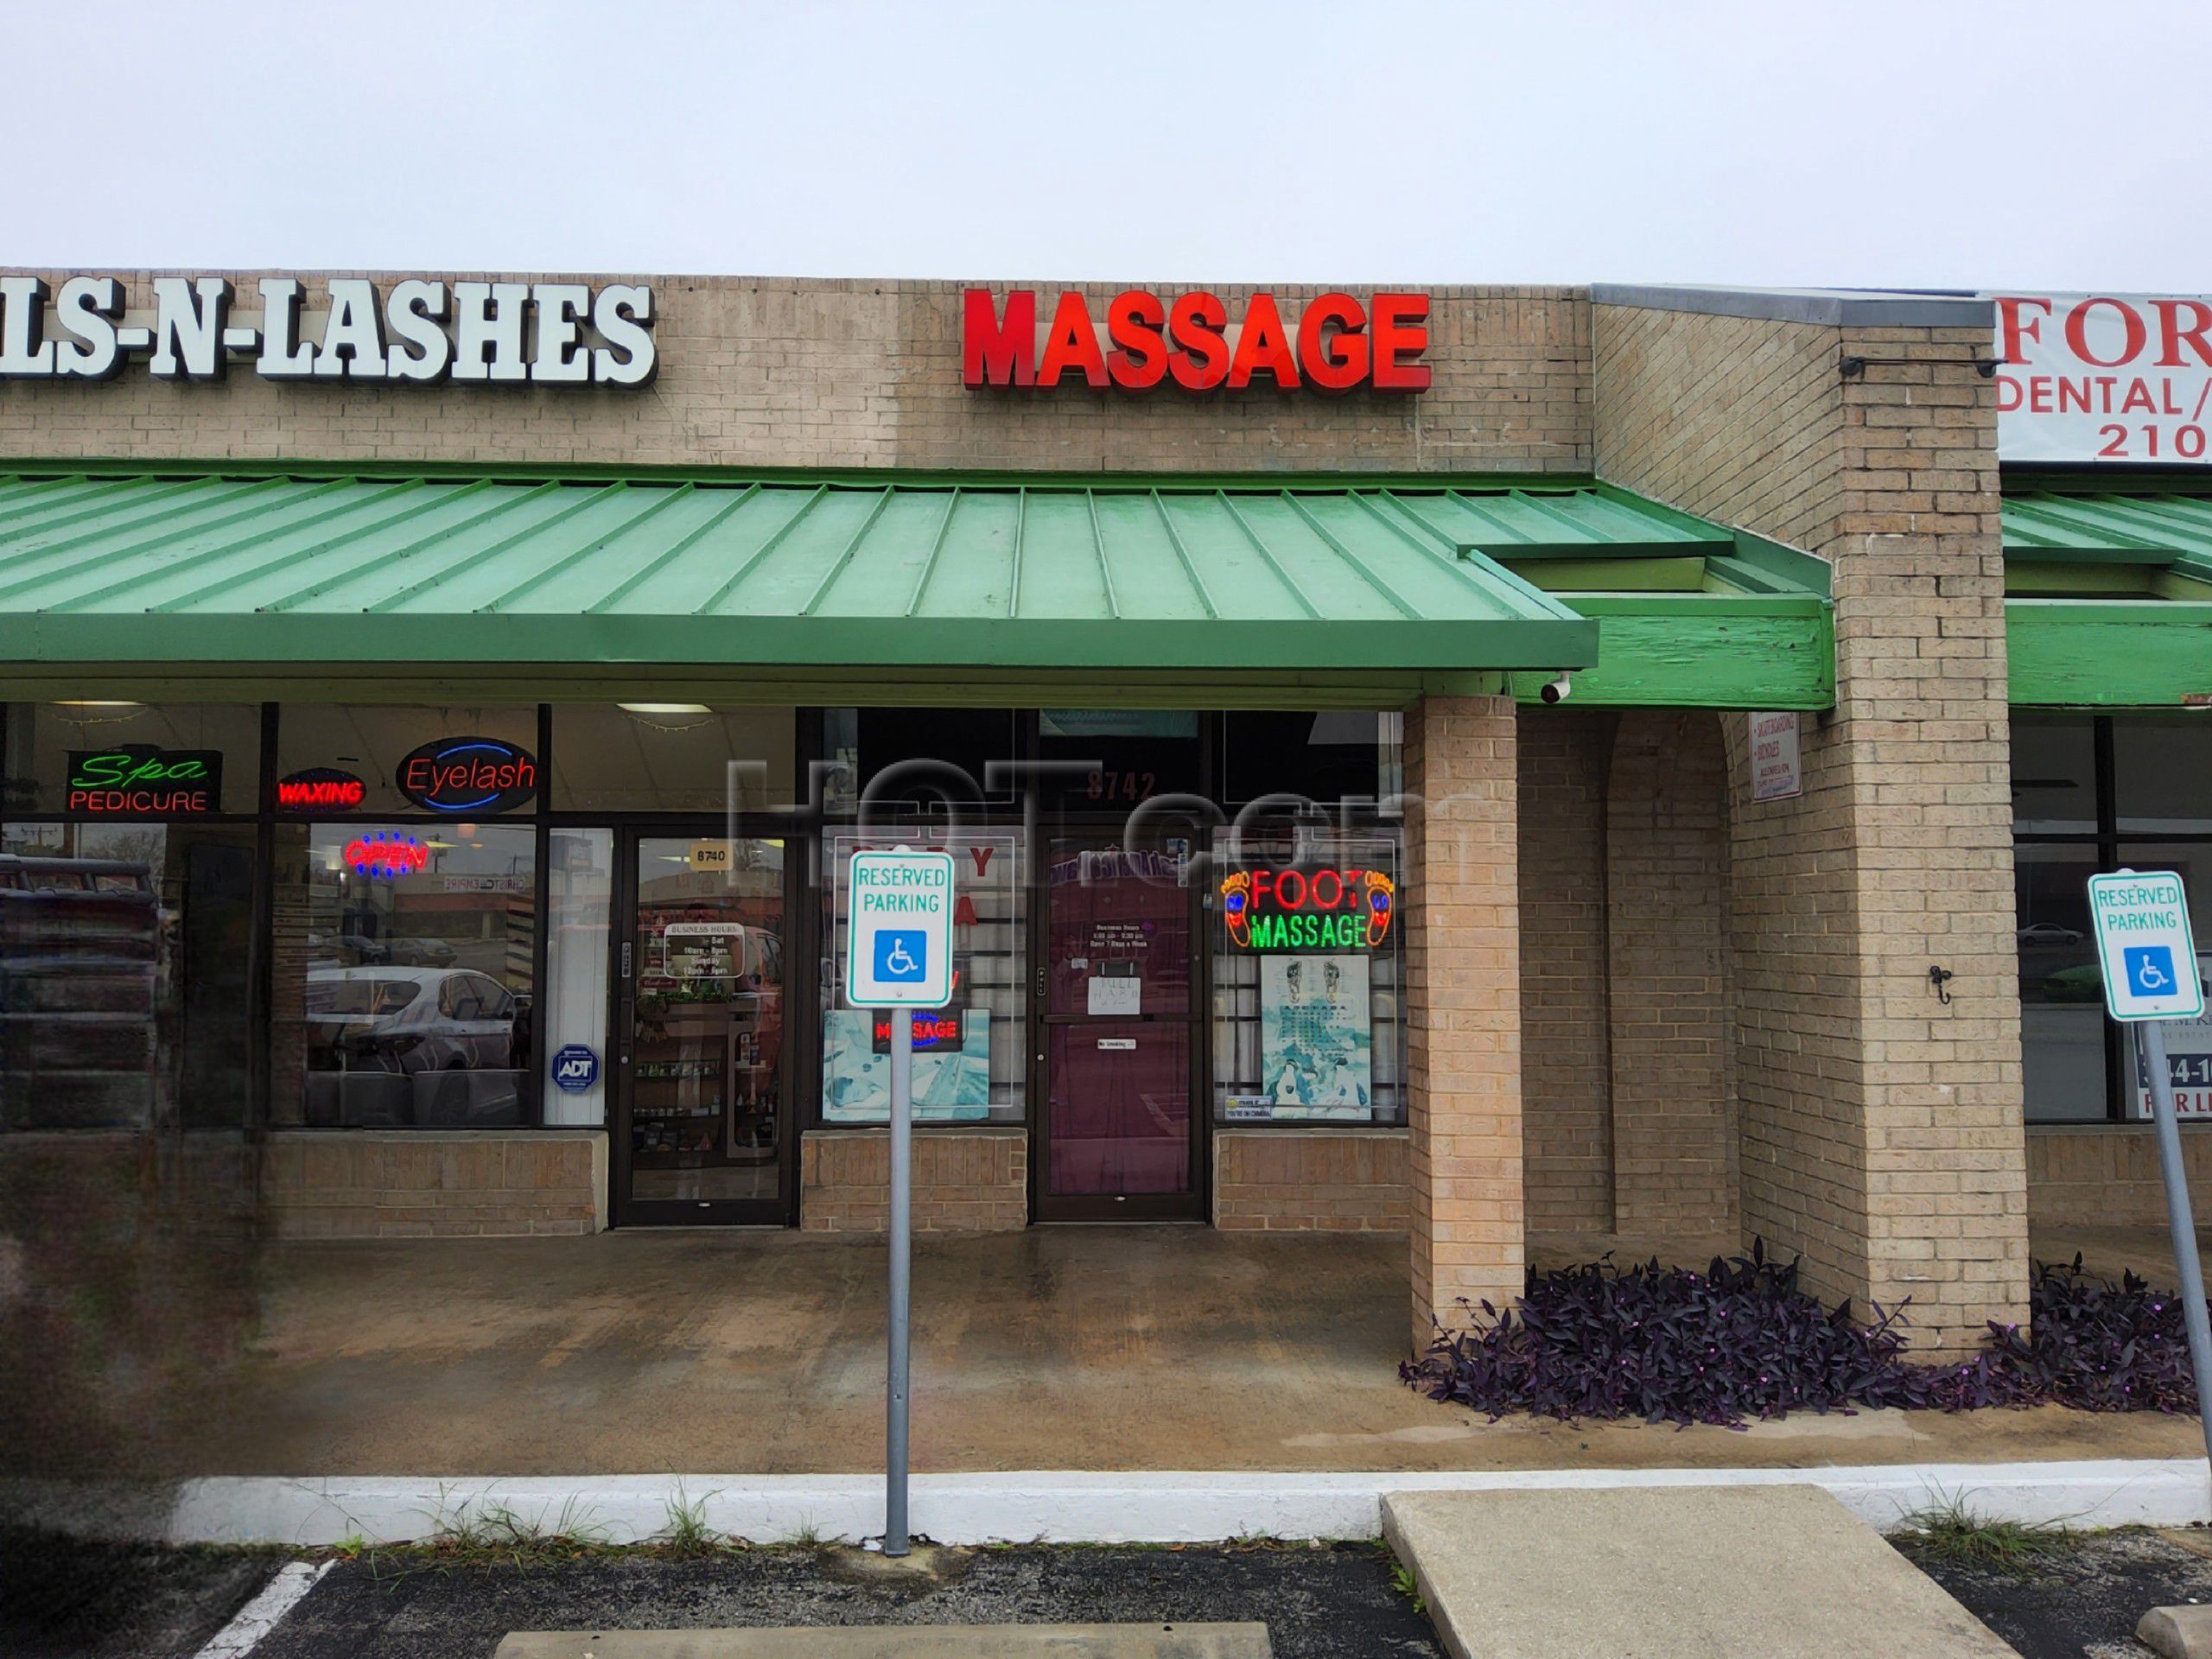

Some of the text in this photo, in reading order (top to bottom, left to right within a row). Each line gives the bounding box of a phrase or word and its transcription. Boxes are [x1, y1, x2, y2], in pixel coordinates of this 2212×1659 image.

[963, 288, 1432, 393] MASSAGE
[2097, 423, 2207, 458] 210
[73, 755, 207, 787] Spa
[406, 757, 536, 797] Eyelash
[278, 782, 363, 804] WAXING
[1087, 770, 1155, 800] 8742
[71, 791, 207, 810] PEDICURE
[346, 841, 429, 869] OPEN
[697, 850, 726, 861] 8740
[858, 868, 946, 887] RESERVED
[1253, 870, 1363, 909] FOOT
[2098, 887, 2177, 906] RESERVED
[864, 893, 939, 912] PARKING
[1251, 914, 1366, 947] MASSAGE
[2108, 911, 2177, 930] PARKING
[875, 1022, 957, 1039] MSAGE
[559, 1060, 592, 1077] ADT
[2145, 1093, 2190, 1113] FR
